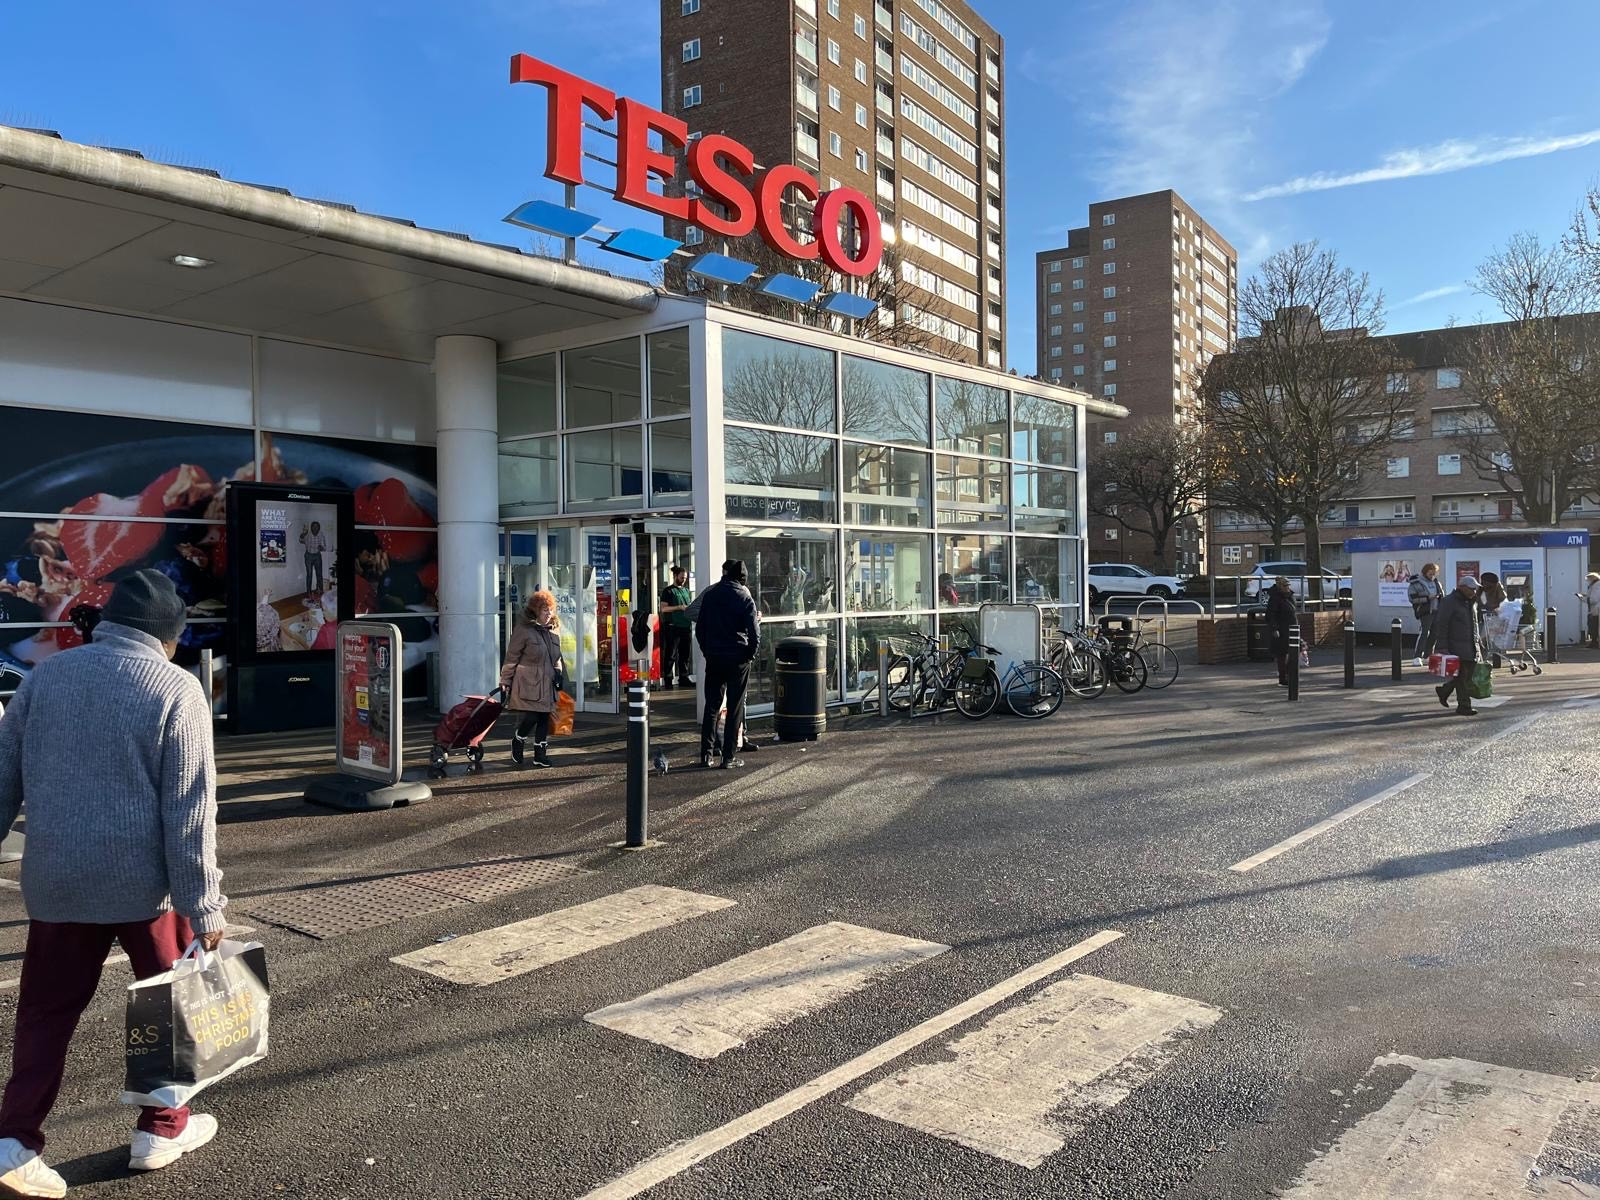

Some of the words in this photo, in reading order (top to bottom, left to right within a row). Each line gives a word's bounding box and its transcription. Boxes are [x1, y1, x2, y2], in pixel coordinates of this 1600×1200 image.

[510, 53, 883, 276] TESCO
[726, 496, 738, 507] nd
[741, 496, 757, 508] less
[786, 499, 800, 514] day
[1419, 538, 1435, 548] ATM
[1567, 535, 1583, 545] ATM
[556, 606, 587, 614] Plasts
[209, 991, 225, 1001] NOT
[191, 1007, 219, 1028] THIS
[223, 1000, 237, 1014] IS
[129, 1025, 159, 1044] &S
[215, 1026, 249, 1052] FOOD
[127, 1047, 149, 1056] OOD
